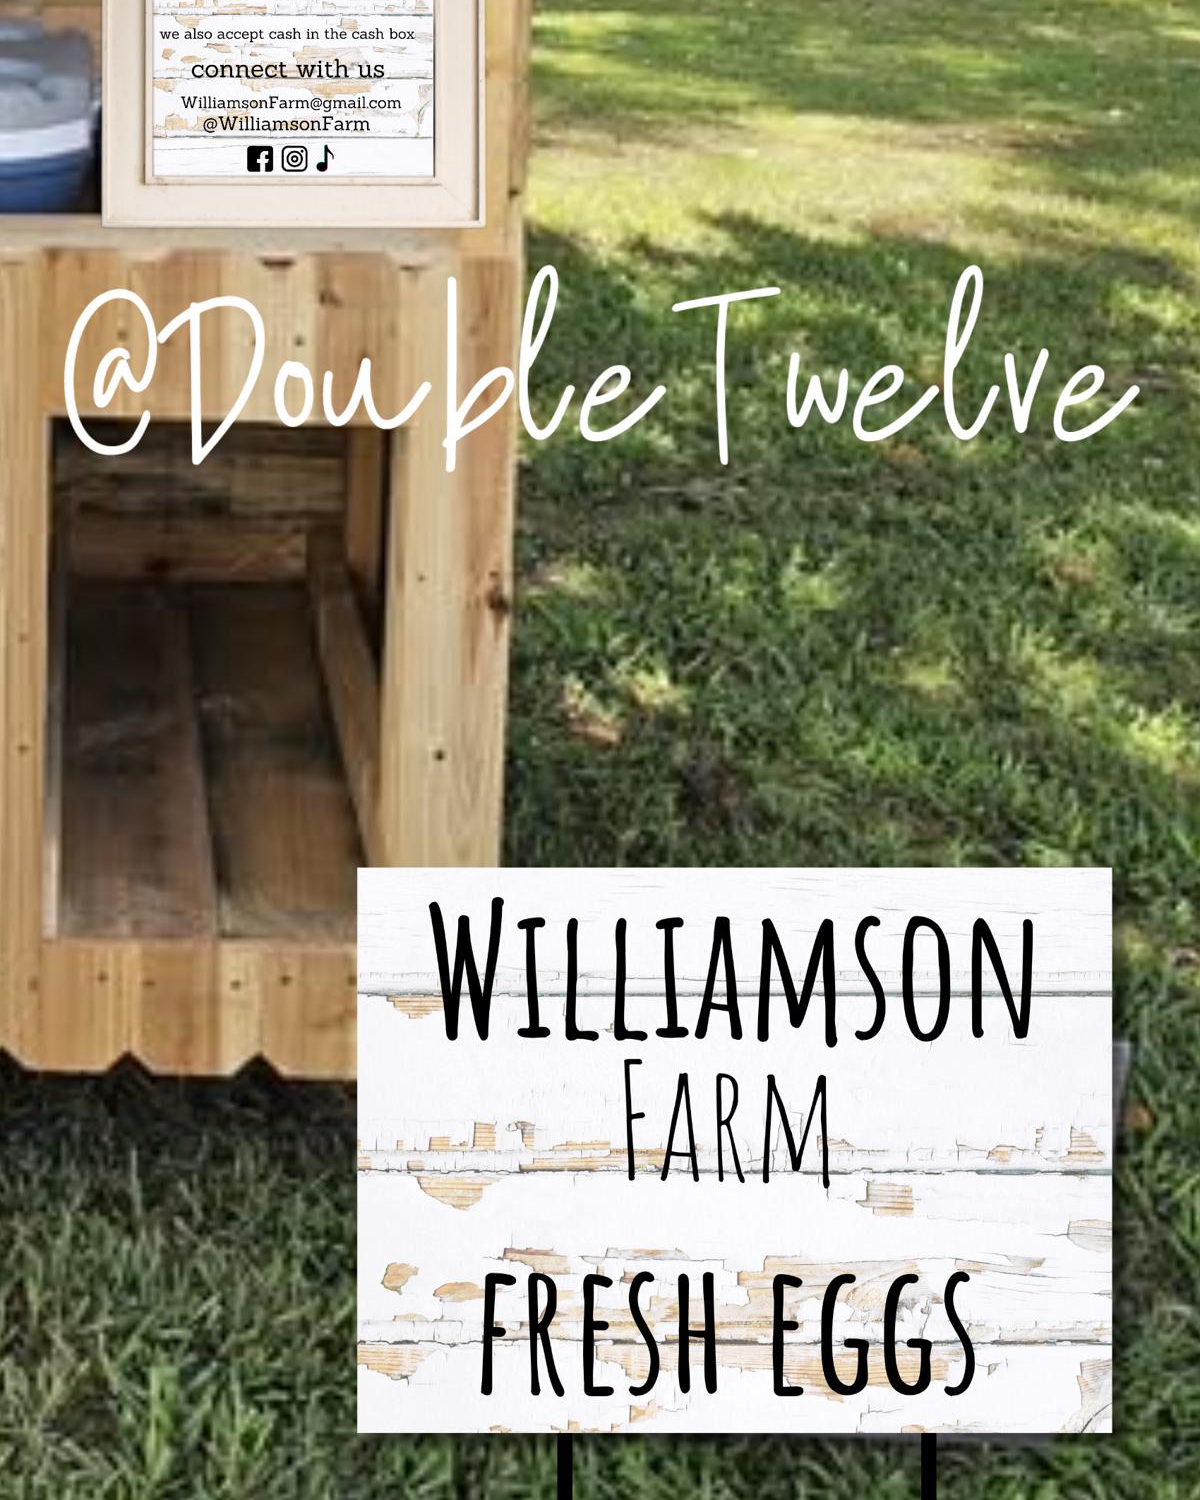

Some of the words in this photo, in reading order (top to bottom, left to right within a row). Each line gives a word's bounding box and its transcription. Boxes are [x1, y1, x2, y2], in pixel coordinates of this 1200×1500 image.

[159, 30, 180, 40] we
[183, 27, 213, 40] also
[216, 29, 265, 44] accept
[268, 27, 302, 40] cash
[306, 30, 320, 40] in
[324, 27, 348, 40] the
[351, 27, 385, 40] cash
[388, 27, 416, 40] box
[191, 61, 290, 80] connect
[293, 58, 351, 80] with
[356, 64, 385, 80] us
[180, 95, 402, 113] WilliamsonFarm@gmail.com
[202, 115, 371, 134] @WilliamsonFarm
[480, 1271, 718, 1398] FRESH
[772, 1271, 976, 1397] EGGS
